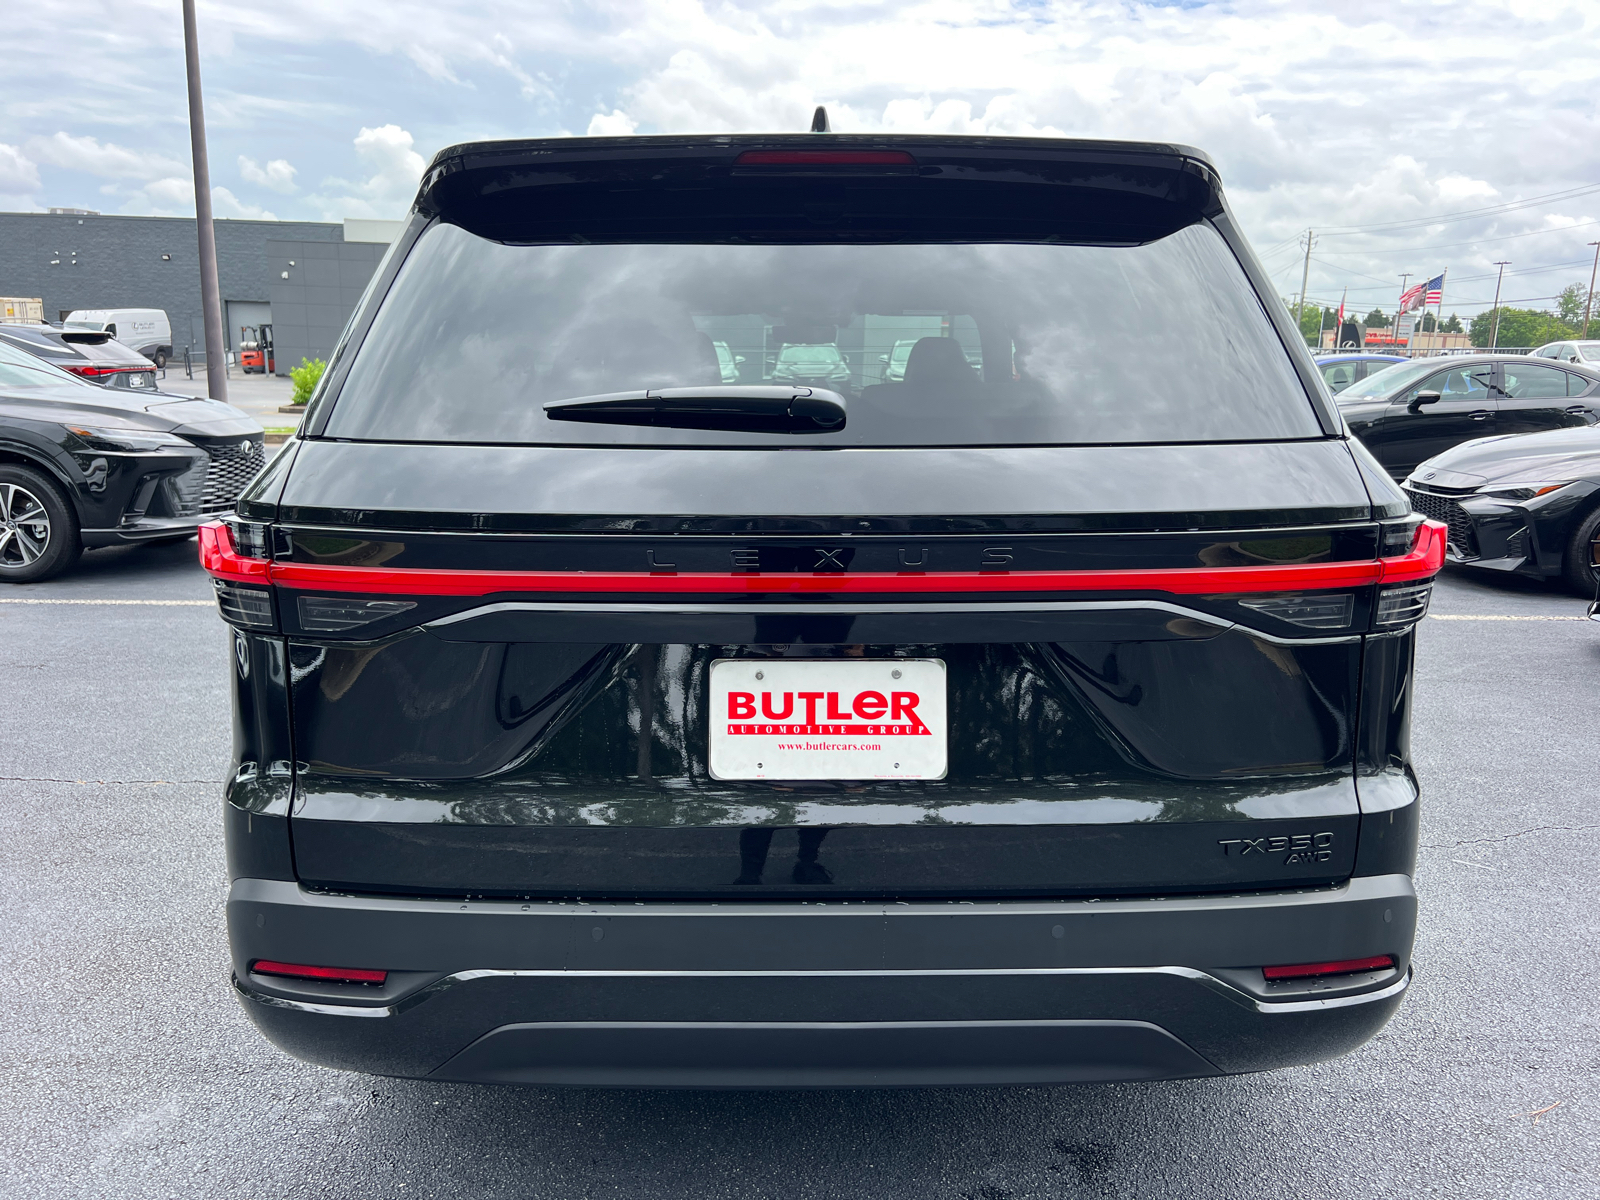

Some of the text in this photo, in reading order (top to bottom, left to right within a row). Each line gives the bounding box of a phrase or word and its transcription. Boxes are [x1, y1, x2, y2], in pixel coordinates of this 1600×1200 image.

[646, 547, 1014, 568] LEXUS
[728, 725, 925, 734] AUTOMOTIVE GROUP
[778, 741, 881, 751] www.butlercars.com
[1283, 850, 1332, 865] AWD
